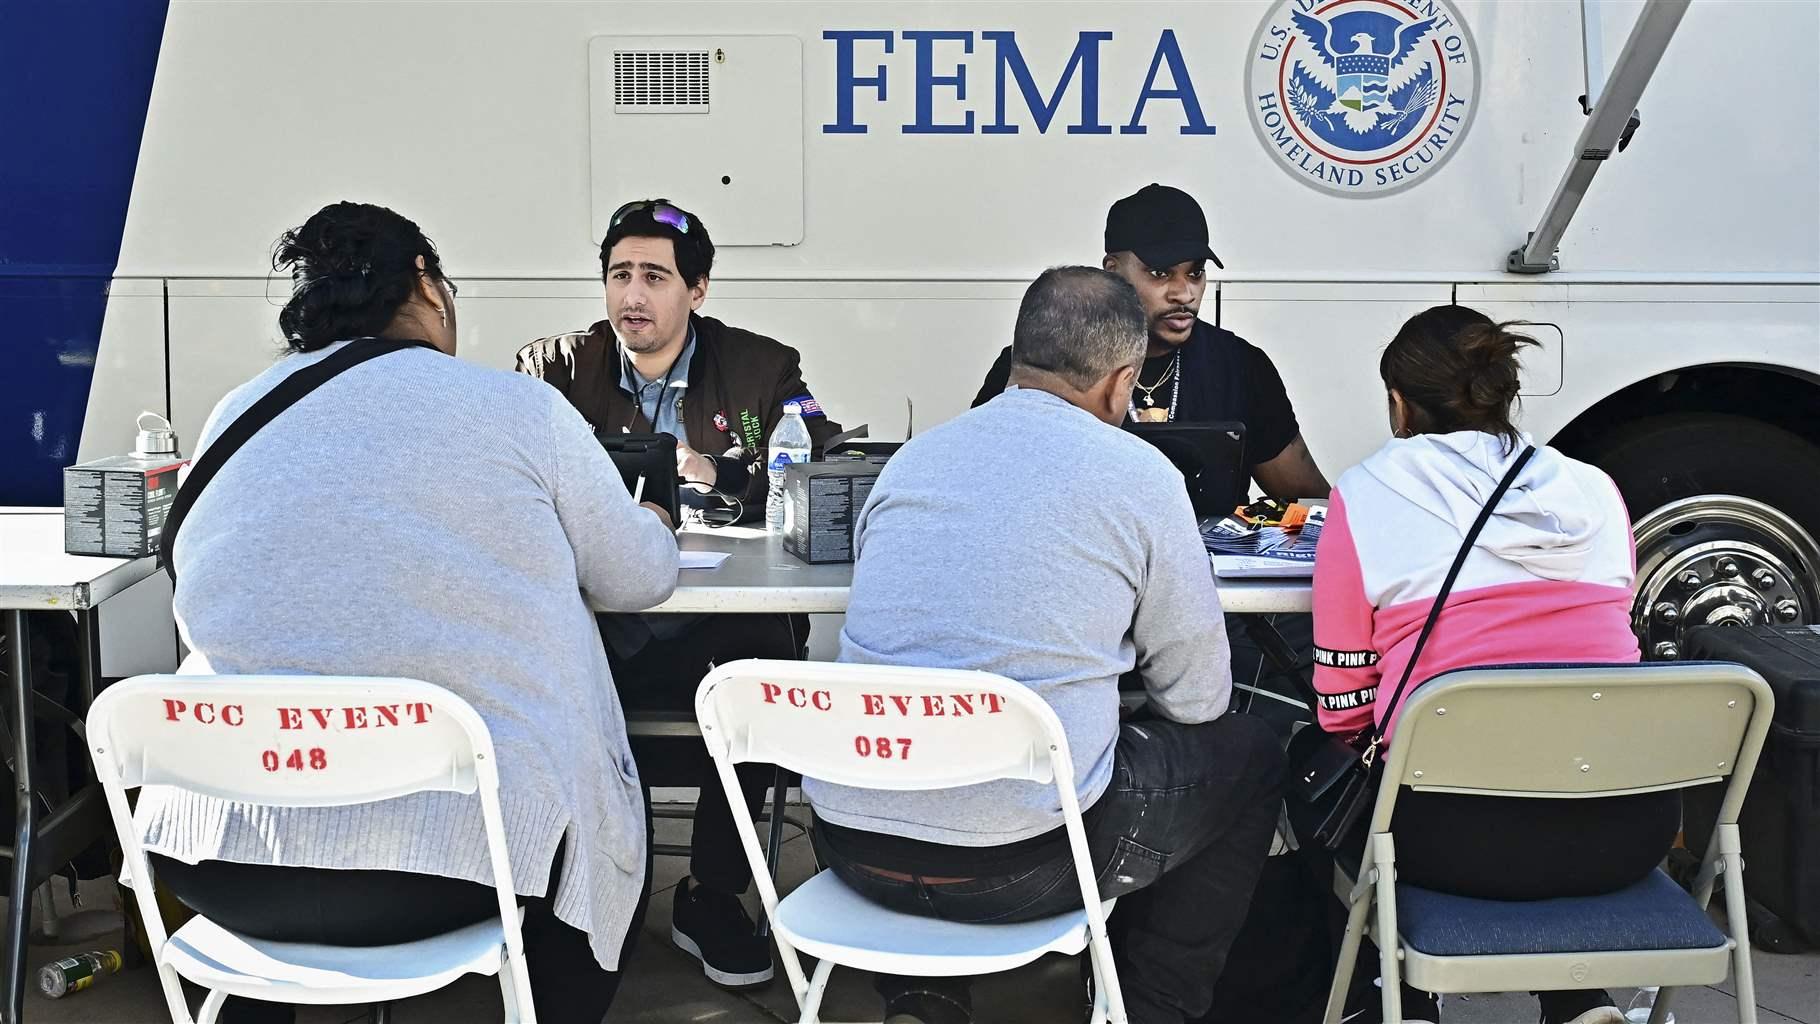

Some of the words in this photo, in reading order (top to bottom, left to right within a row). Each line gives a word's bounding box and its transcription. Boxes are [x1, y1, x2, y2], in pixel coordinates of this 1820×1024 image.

[1260, 24, 1291, 61] U.S.
[1444, 35, 1467, 65] OF
[823, 29, 1216, 135] FEMA
[1258, 91, 1364, 187] HOMELAND
[1375, 92, 1466, 186] SECURITY
[740, 408, 756, 448] CRYSTAL
[750, 415, 761, 440] JOCK
[1315, 648, 1334, 666] PINK
[1337, 652, 1367, 666] PINK
[163, 699, 244, 727] PCC
[277, 702, 433, 730] EVENT
[762, 682, 832, 711] PCC
[861, 692, 1006, 717] EVENT
[1328, 692, 1358, 709] PINK
[261, 747, 327, 772] 048
[854, 735, 913, 760] 087
